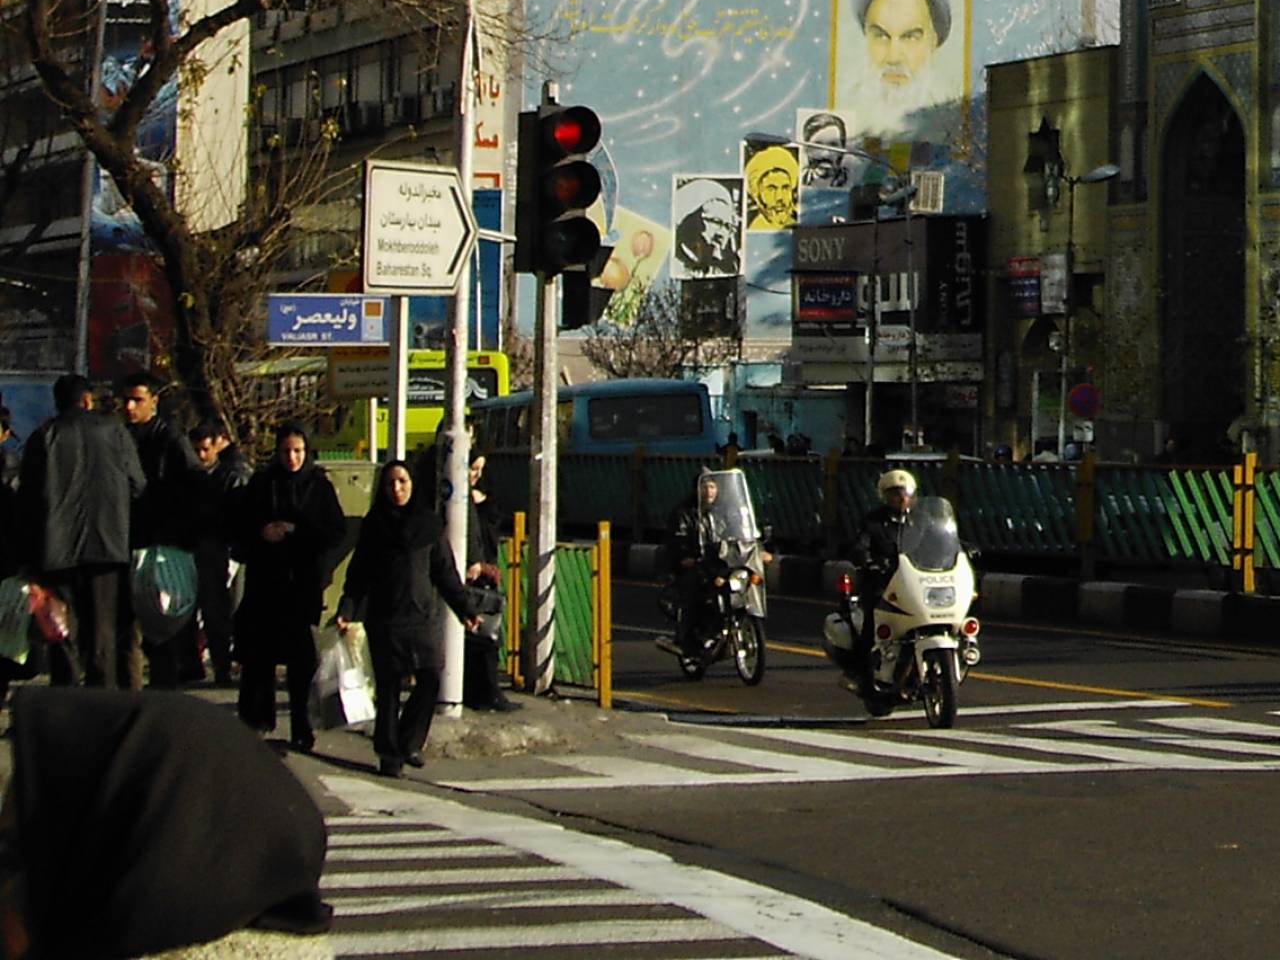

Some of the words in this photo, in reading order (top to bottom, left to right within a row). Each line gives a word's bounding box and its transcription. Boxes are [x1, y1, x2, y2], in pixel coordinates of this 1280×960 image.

[380, 211, 416, 232] بهارستان
[418, 213, 441, 234] میدان
[797, 237, 847, 263] SONY
[803, 288, 852, 307] داروخانه
[291, 308, 357, 331] ولیعصر
[919, 576, 956, 584] POLICE
